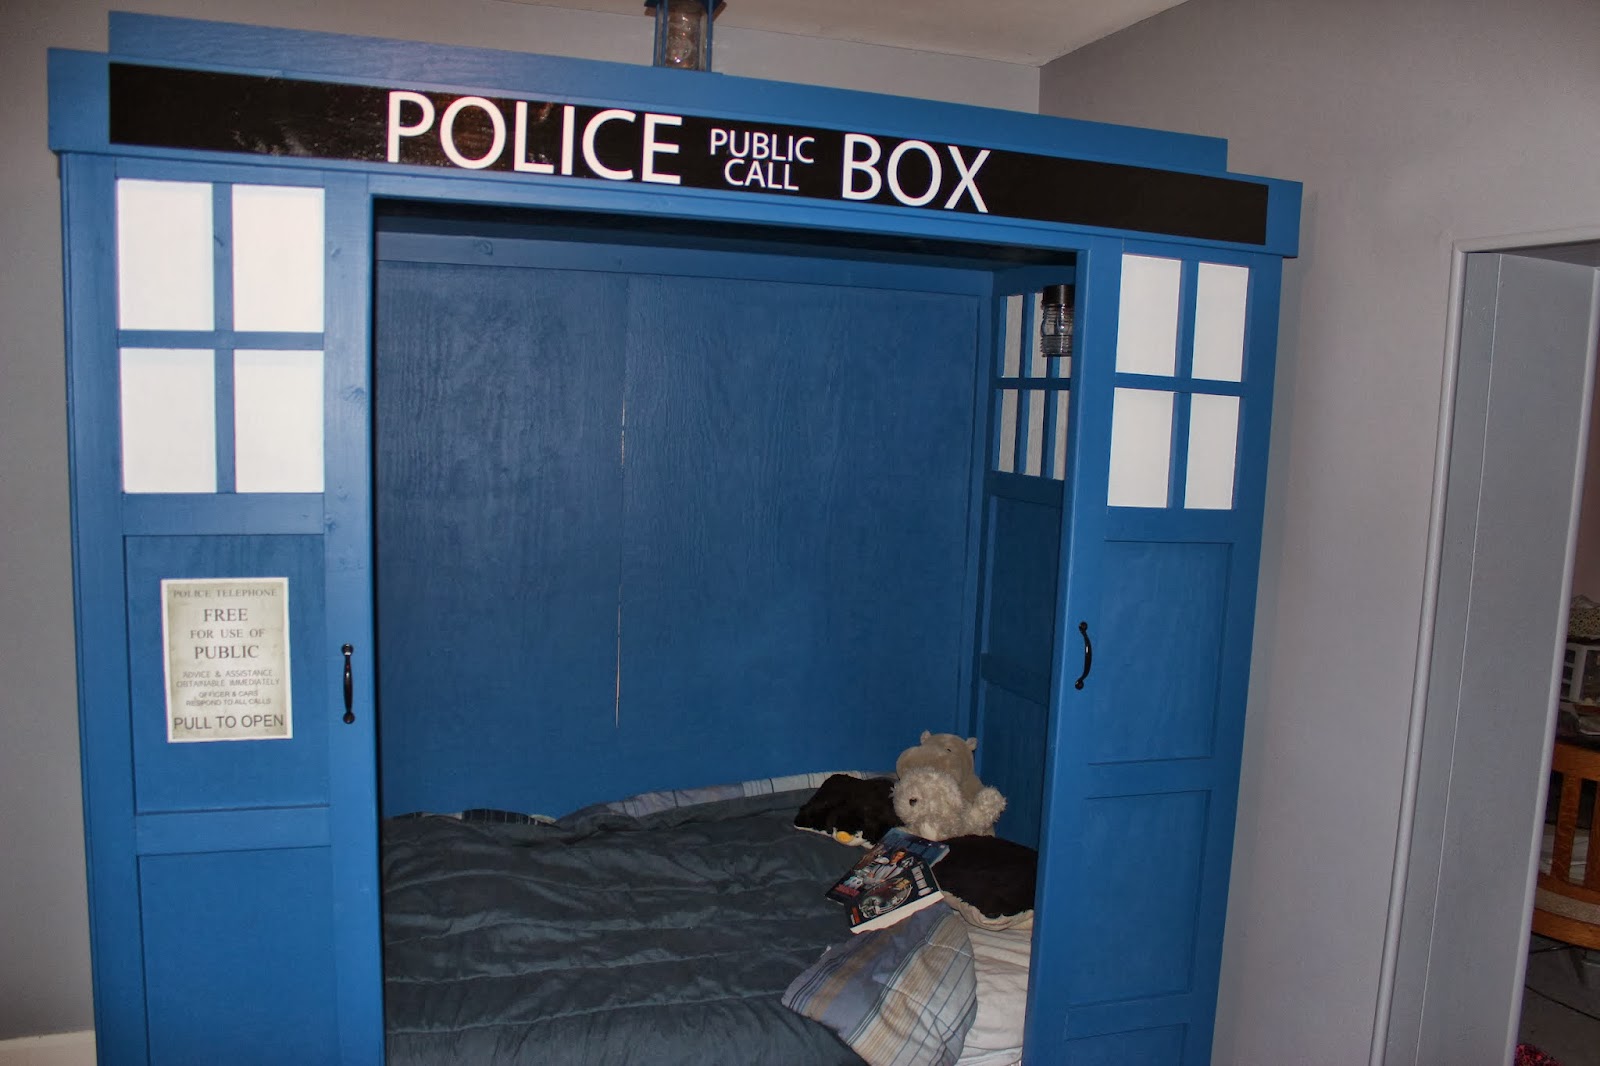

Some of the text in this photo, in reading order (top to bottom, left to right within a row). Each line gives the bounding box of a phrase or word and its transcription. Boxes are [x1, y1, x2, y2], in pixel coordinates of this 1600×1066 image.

[386, 91, 991, 213] POLICE PUBLIC BOX
[724, 158, 799, 192] CALL
[173, 589, 278, 598] POLICE TELEPHONE
[204, 608, 248, 622] FREE
[190, 629, 265, 639] FOR USE OF
[195, 645, 259, 659] PUBLIC
[183, 670, 211, 678] ADVICE
[225, 669, 273, 677] ASSISTANCE
[176, 678, 280, 688] OBTAINABLE IMMEDIATELY
[186, 699, 222, 707] RESPOND
[234, 698, 247, 706] ALL
[174, 715, 283, 730] PULL TO OPEN
